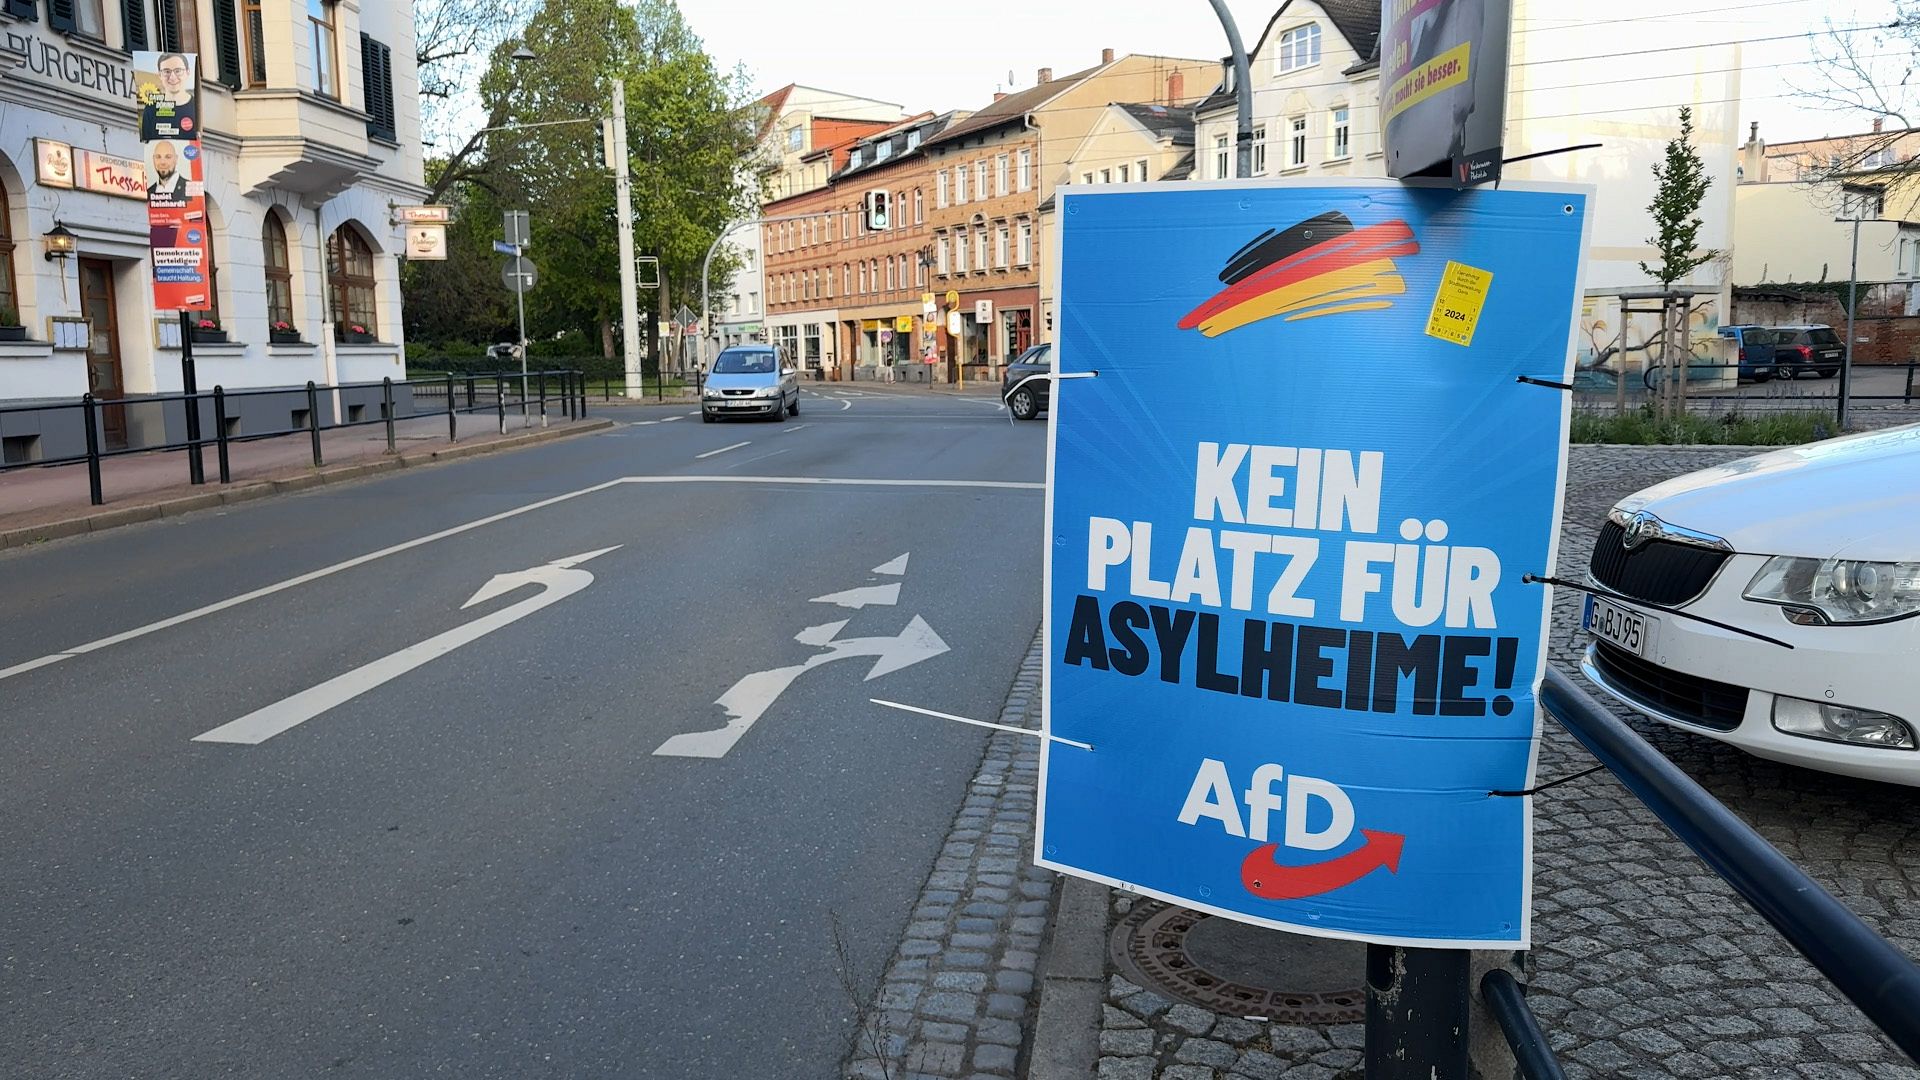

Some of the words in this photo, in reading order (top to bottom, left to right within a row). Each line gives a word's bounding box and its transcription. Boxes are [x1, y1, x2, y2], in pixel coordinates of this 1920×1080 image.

[1414, 71, 1425, 94] sie
[1427, 58, 1461, 88] besser.
[150, 200, 186, 208] Reinhardt
[156, 258, 198, 266] verteidigen
[1444, 308, 1466, 322] 2024
[1194, 441, 1384, 534] KEIN
[1087, 516, 1320, 618] PLATZ
[1340, 518, 1501, 629] FÜR
[1063, 594, 1519, 717] ASYLHEIME!
[1176, 757, 1356, 851] AfD
